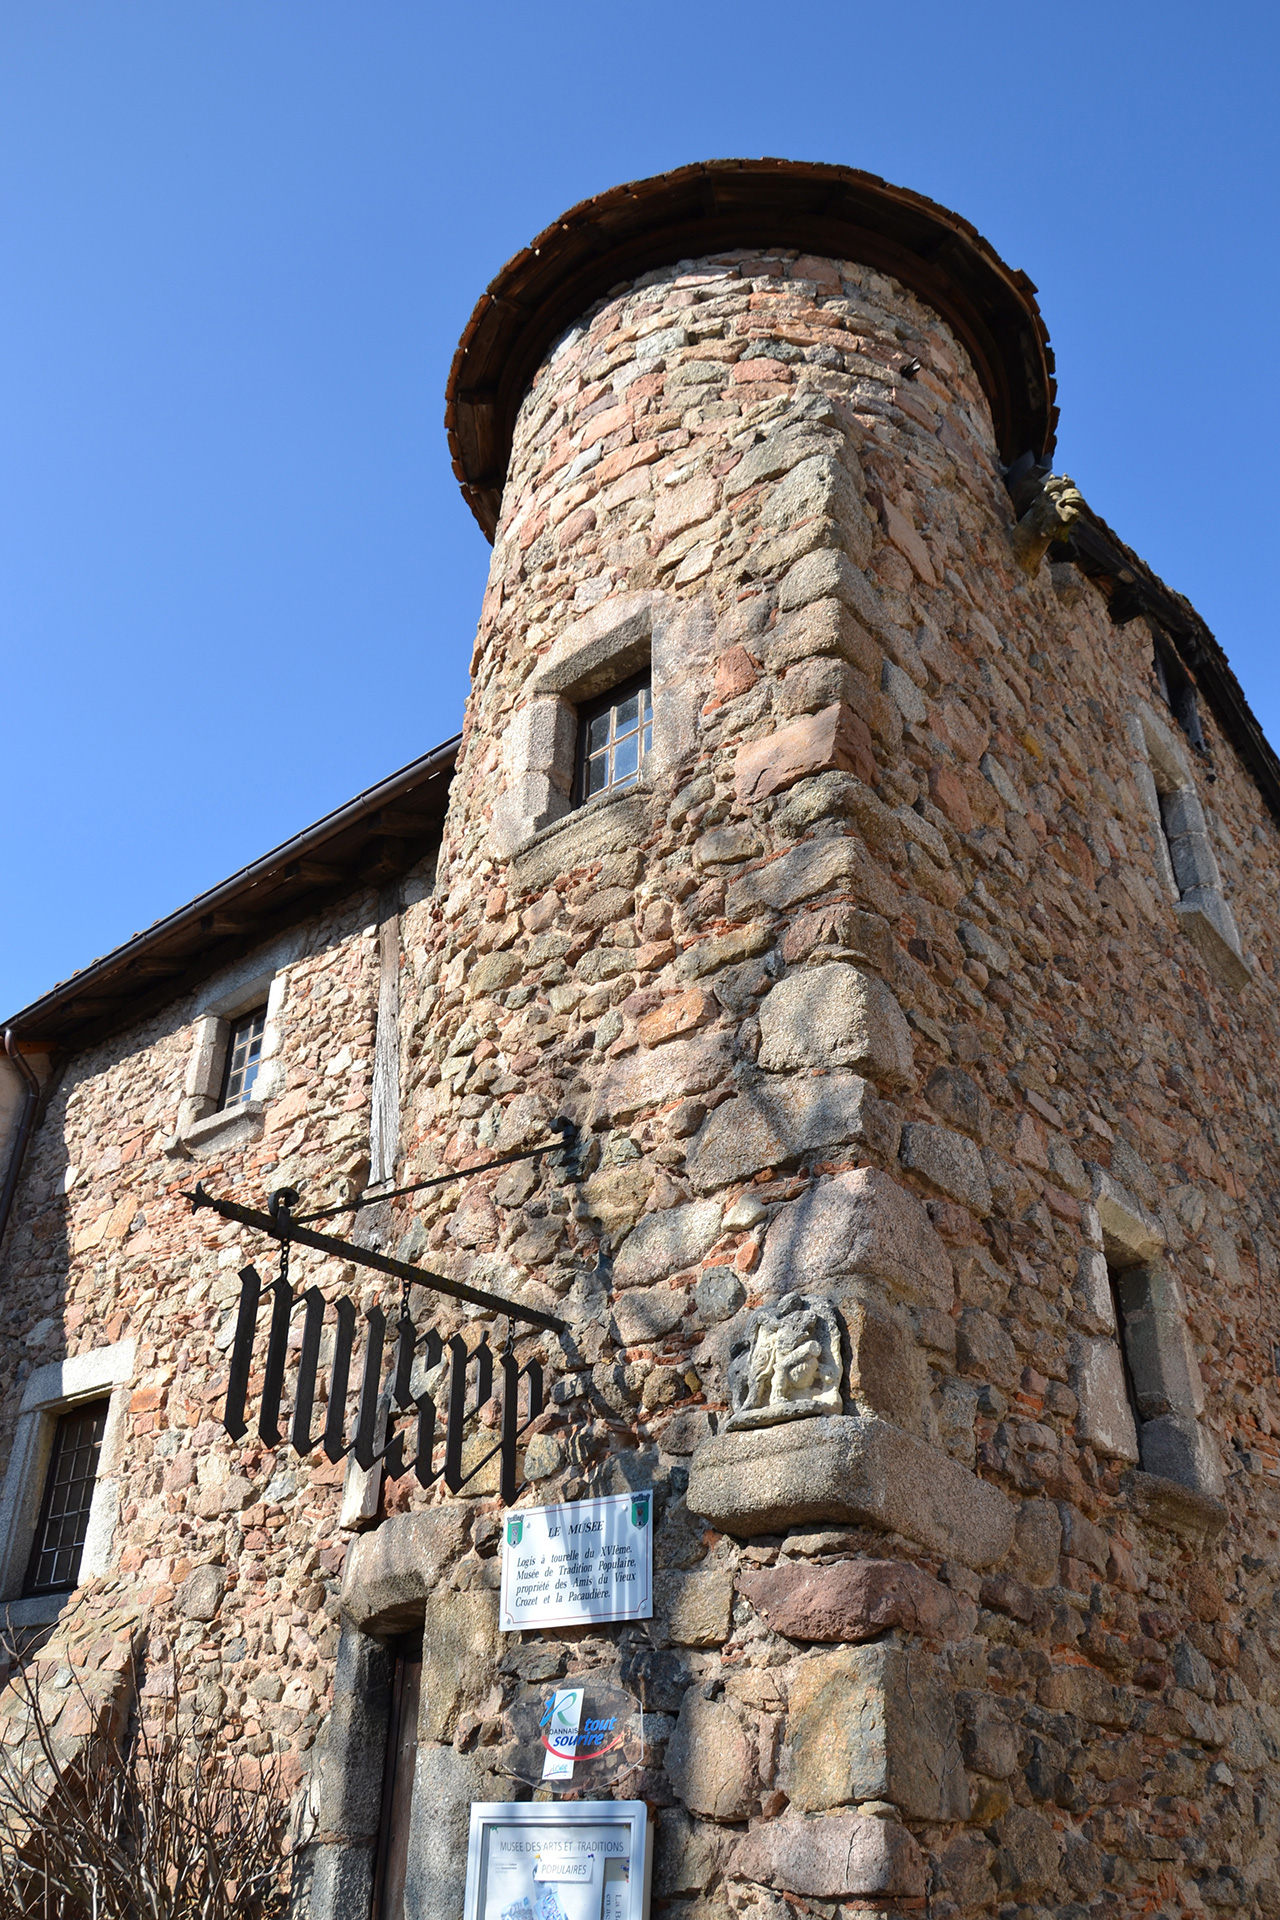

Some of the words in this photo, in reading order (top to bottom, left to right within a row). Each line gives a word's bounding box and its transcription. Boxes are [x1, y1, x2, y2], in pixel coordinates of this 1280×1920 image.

[548, 1526, 561, 1538] LE
[568, 1520, 604, 1535] MUSEE
[517, 1556, 536, 1568] Logis
[541, 1555, 546, 1564] à
[551, 1550, 579, 1563] tourelle
[585, 1548, 594, 1558] du
[600, 1545, 633, 1557] XVIème.
[516, 1569, 539, 1580] Musée
[545, 1567, 553, 1577] de
[559, 1563, 592, 1576] Tradition
[598, 1558, 637, 1571] Populaire,
[516, 1581, 549, 1596] propriété
[555, 1579, 567, 1590] des
[572, 1576, 593, 1588] Amis
[598, 1574, 608, 1585] du
[615, 1571, 637, 1583] Vieux
[515, 1596, 538, 1607] Crozet
[543, 1595, 550, 1604] et
[556, 1592, 563, 1603] la
[584, 1716, 618, 1732] tout
[553, 1731, 605, 1747] sourire
[500, 1841, 524, 1852] MUSEE
[526, 1841, 541, 1852] DES
[543, 1841, 562, 1851] ARTS
[564, 1841, 573, 1851] ET
[577, 1841, 624, 1852] TRADITIONS
[541, 1864, 587, 1875] POPULAIRES
